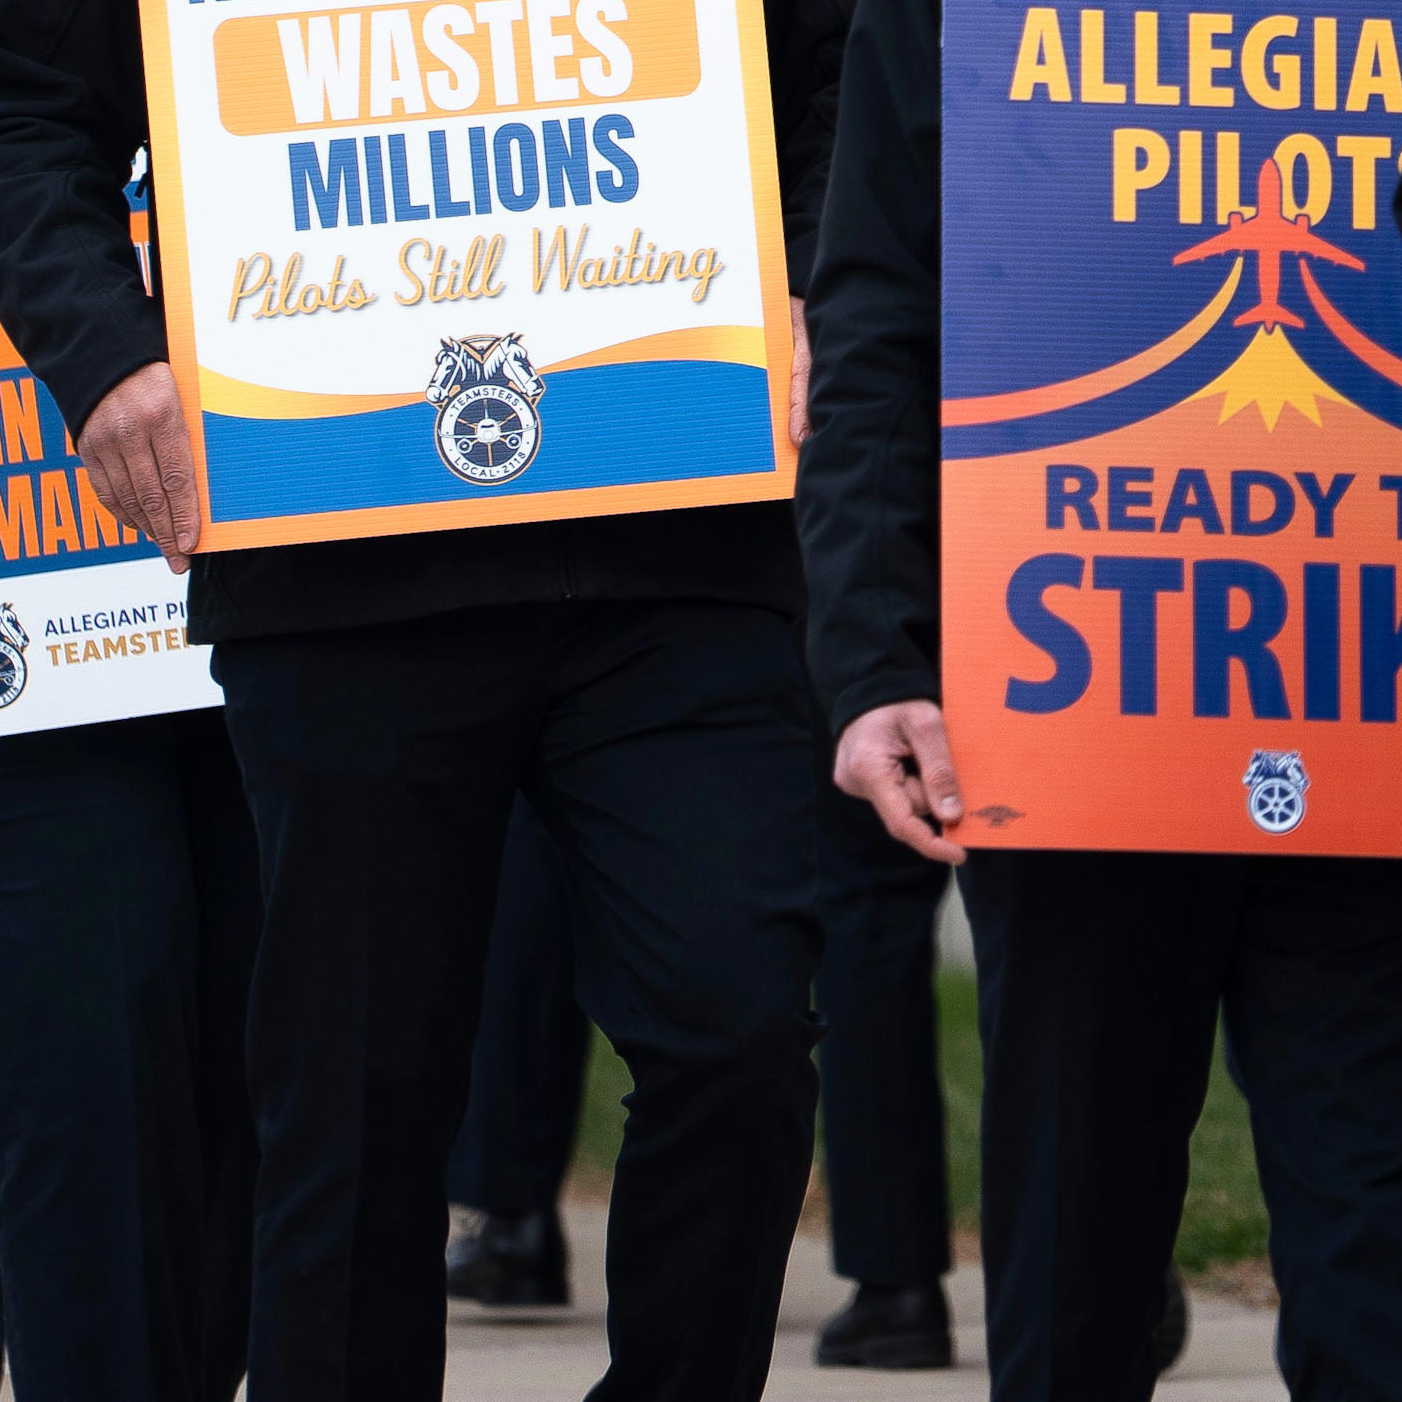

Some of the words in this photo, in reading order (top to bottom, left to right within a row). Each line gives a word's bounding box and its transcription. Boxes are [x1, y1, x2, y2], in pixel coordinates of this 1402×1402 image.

[287, 113, 640, 232] MILLIONS
[227, 251, 376, 322] Pilots
[393, 233, 506, 310] Still
[530, 222, 726, 304] Waiting
[450, 387, 520, 411] TEAMSTERS
[454, 455, 496, 478] LOCAL
[503, 451, 526, 474] 2118
[1045, 464, 1356, 539] READY
[44, 604, 159, 638] ALLEGIANT
[165, 601, 186, 621] PI
